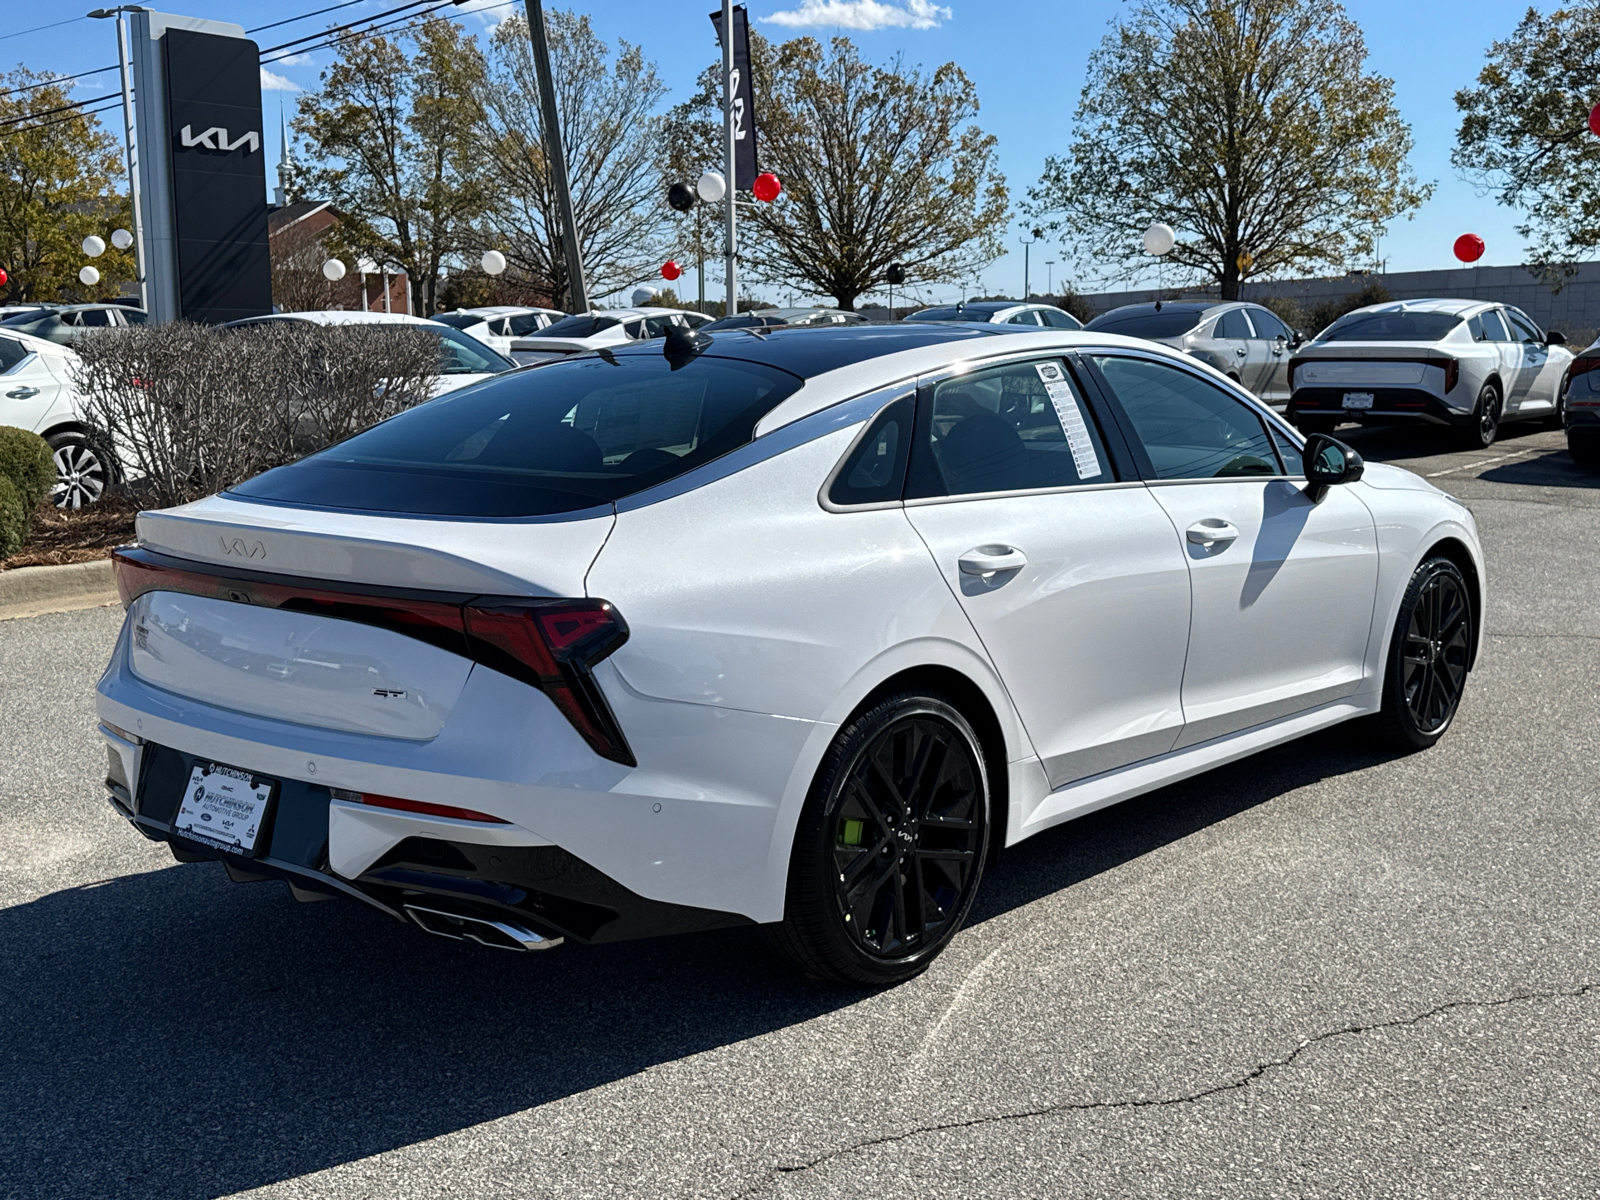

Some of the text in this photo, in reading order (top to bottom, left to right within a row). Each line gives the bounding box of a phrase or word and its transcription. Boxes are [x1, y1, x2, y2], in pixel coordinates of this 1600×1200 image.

[180, 123, 260, 153] KIA
[220, 536, 267, 559] KIA
[215, 765, 254, 782] HUTCHINSON
[202, 803, 232, 817] AUTOMOTIVE
[232, 811, 250, 821] GROUP
[204, 792, 255, 814] HUTCHINSON
